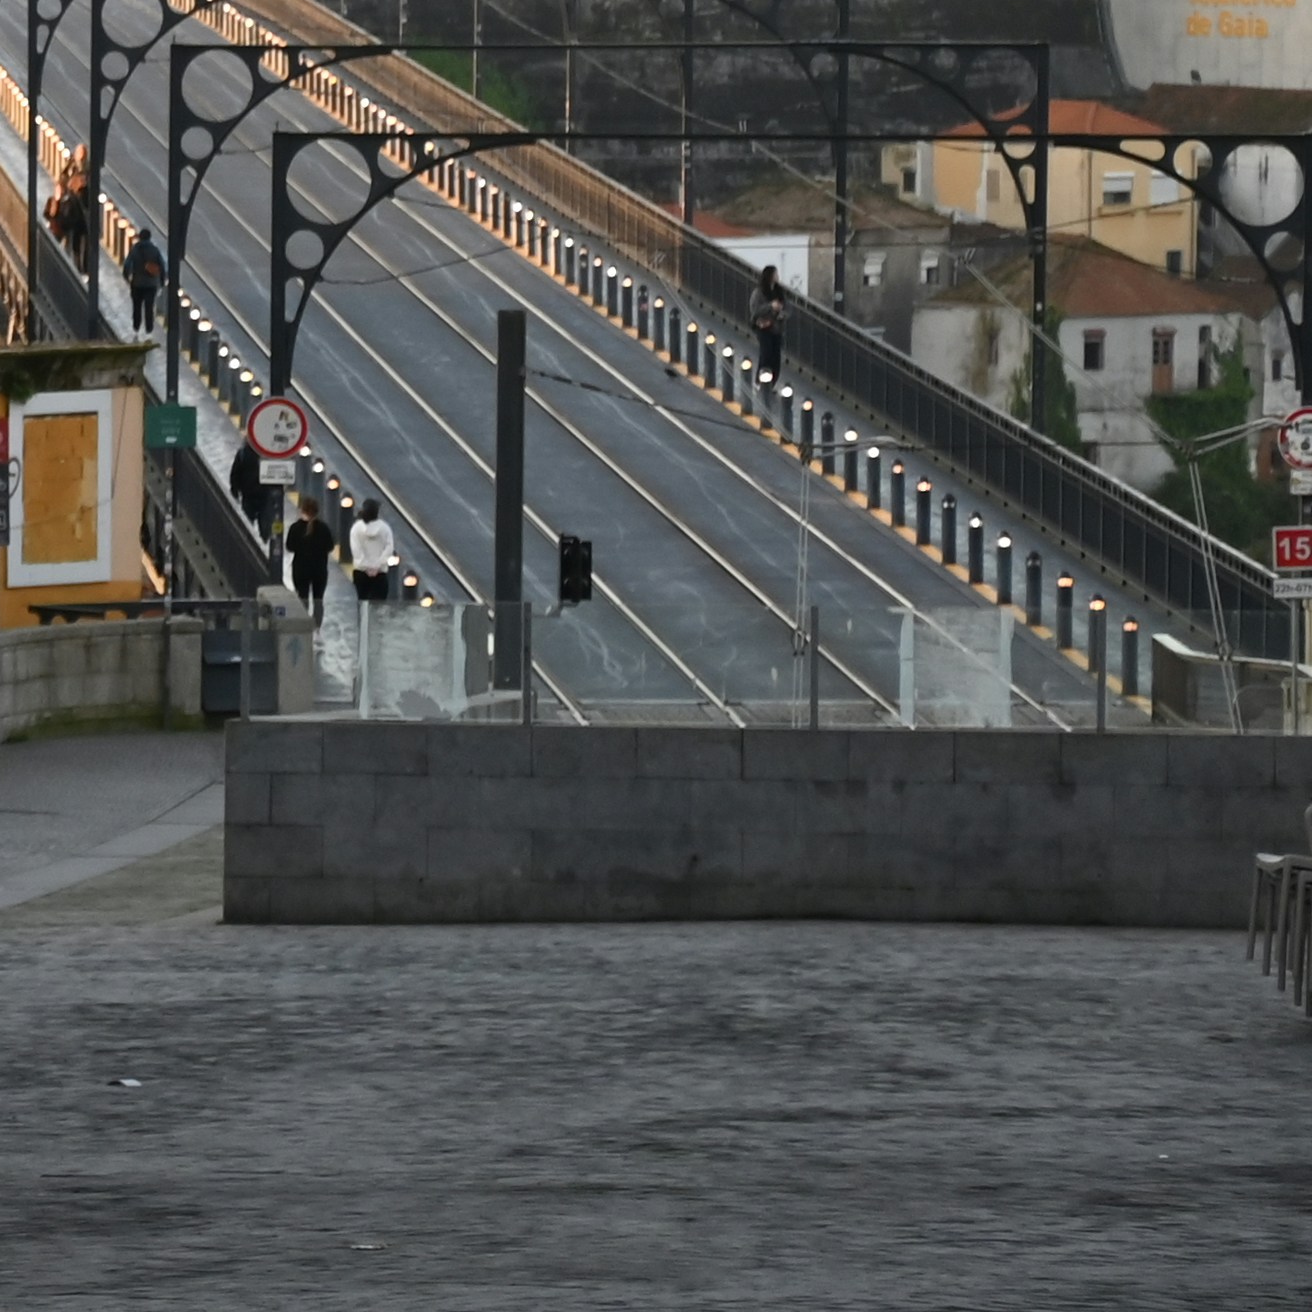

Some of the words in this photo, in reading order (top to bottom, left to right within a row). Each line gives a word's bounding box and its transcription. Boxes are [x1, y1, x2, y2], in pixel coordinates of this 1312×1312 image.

[1187, 11, 1212, 37] de
[1219, 11, 1269, 38] Gaia
[1279, 536, 1311, 561] 15
